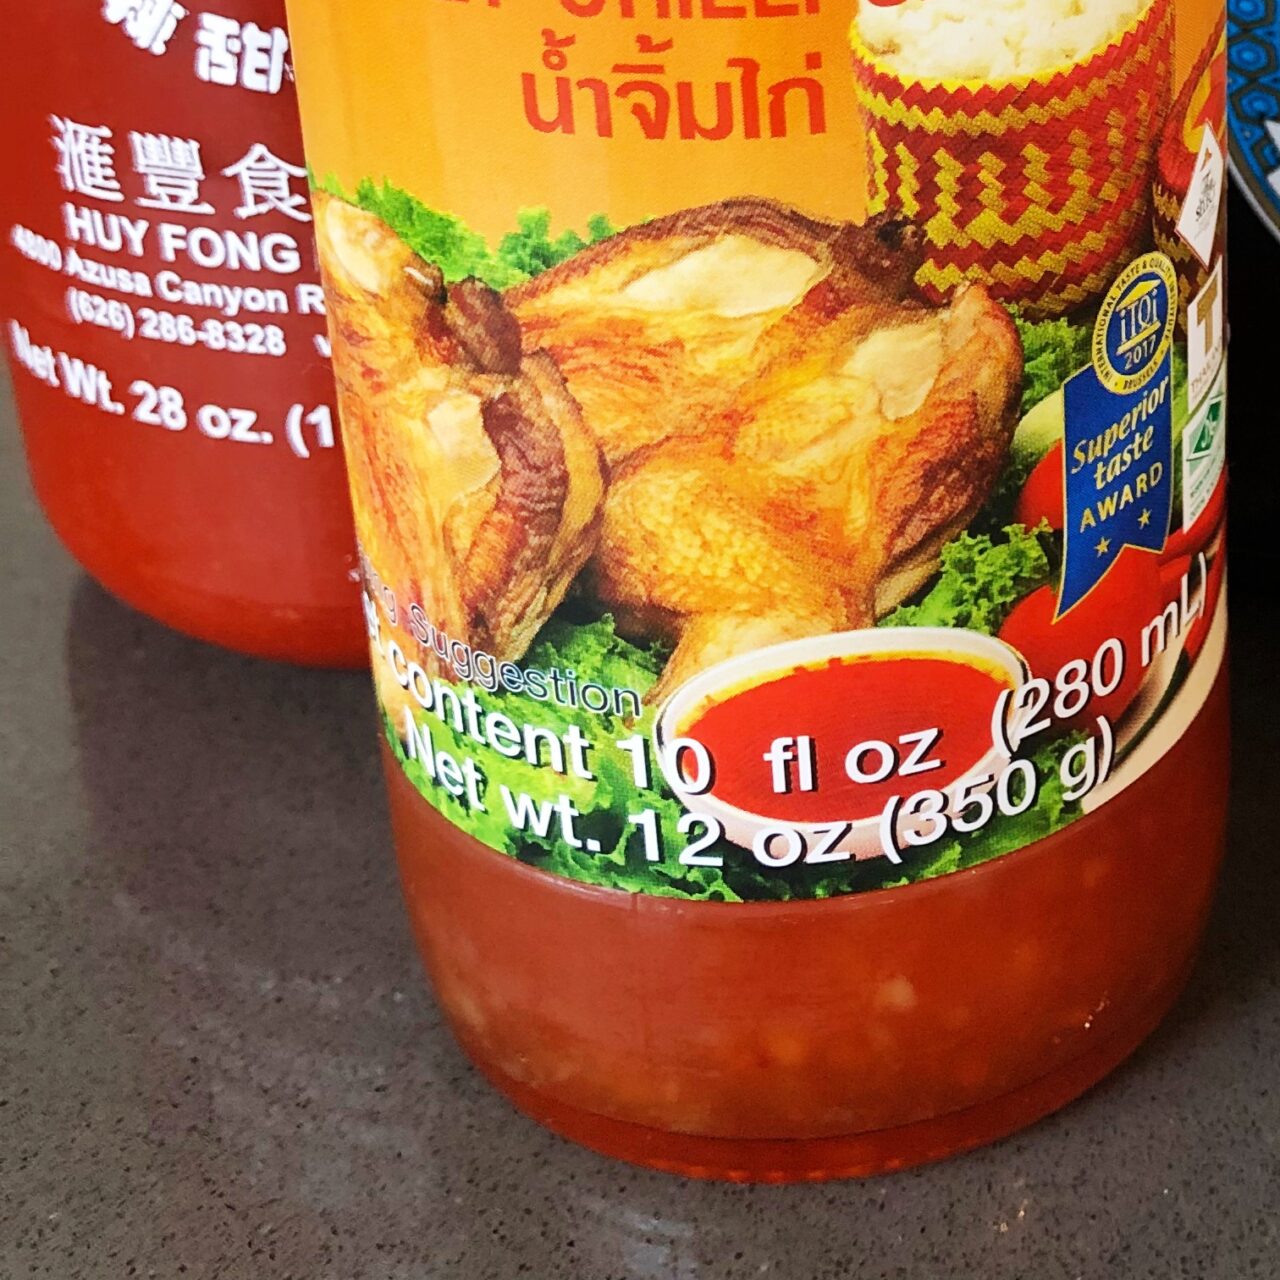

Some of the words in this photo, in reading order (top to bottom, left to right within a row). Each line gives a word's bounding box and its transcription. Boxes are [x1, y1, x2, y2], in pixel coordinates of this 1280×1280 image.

[522, 28, 826, 140] น้ำจิ้มไก่
[64, 202, 148, 256] HUY
[158, 223, 300, 273] FONG
[65, 246, 152, 296] Azusa
[156, 271, 288, 316] Canyon
[137, 308, 286, 356] 286-8328
[1124, 334, 1157, 371] 2017
[130, 380, 187, 430] 28
[197, 404, 273, 443] oz.
[1071, 375, 1169, 475] Superior
[1093, 425, 1154, 490] taste
[1079, 461, 1163, 534] AWARD
[387, 637, 592, 780] content
[616, 734, 711, 794] 10
[763, 735, 813, 793] fl
[844, 727, 942, 784] oz
[991, 638, 1123, 759] (280
[1140, 551, 1207, 666] mL)
[408, 603, 642, 718] Suggestion
[405, 705, 486, 812] Net
[500, 784, 600, 852] wt.
[627, 810, 723, 867] 12
[752, 822, 852, 867] oz
[879, 758, 1037, 864] (350
[1060, 716, 1112, 800] g)
